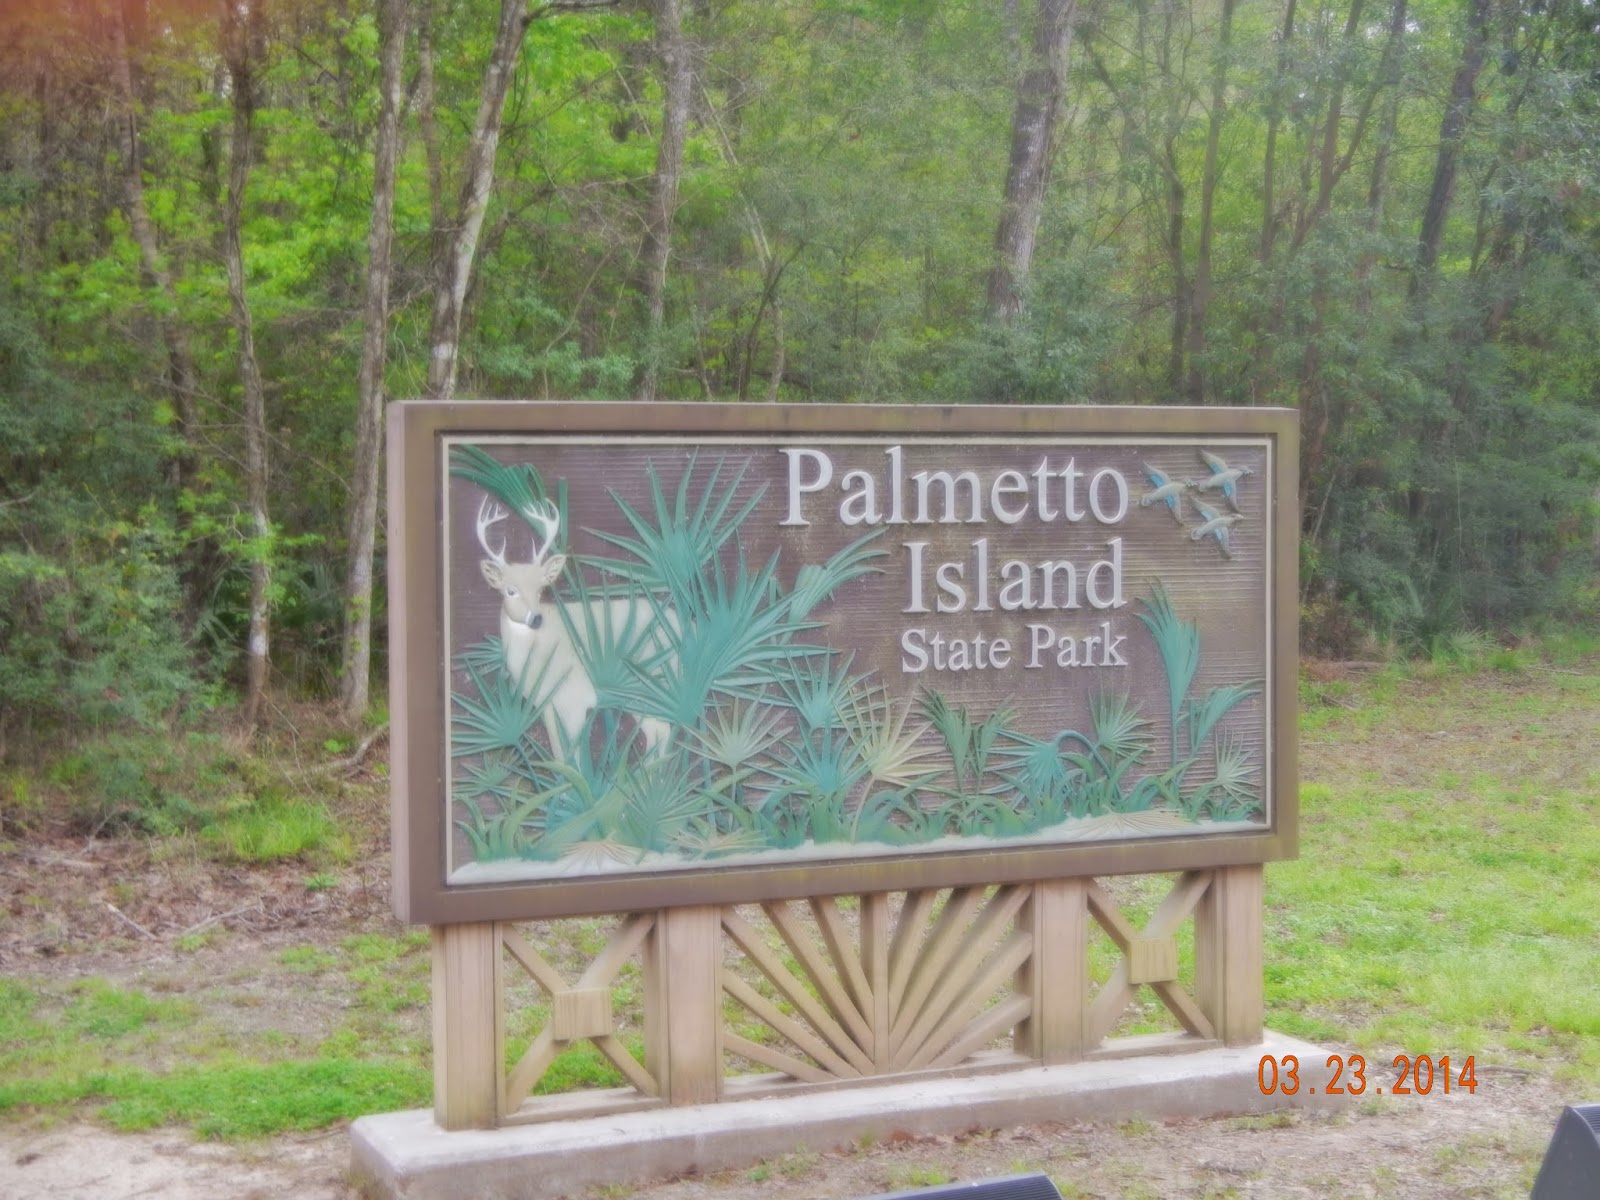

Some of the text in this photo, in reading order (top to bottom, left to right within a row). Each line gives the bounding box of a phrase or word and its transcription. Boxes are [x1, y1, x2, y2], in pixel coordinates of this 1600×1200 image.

[779, 445, 1128, 526] Palmetto
[902, 537, 1127, 614] Island
[901, 622, 1128, 673] State Park
